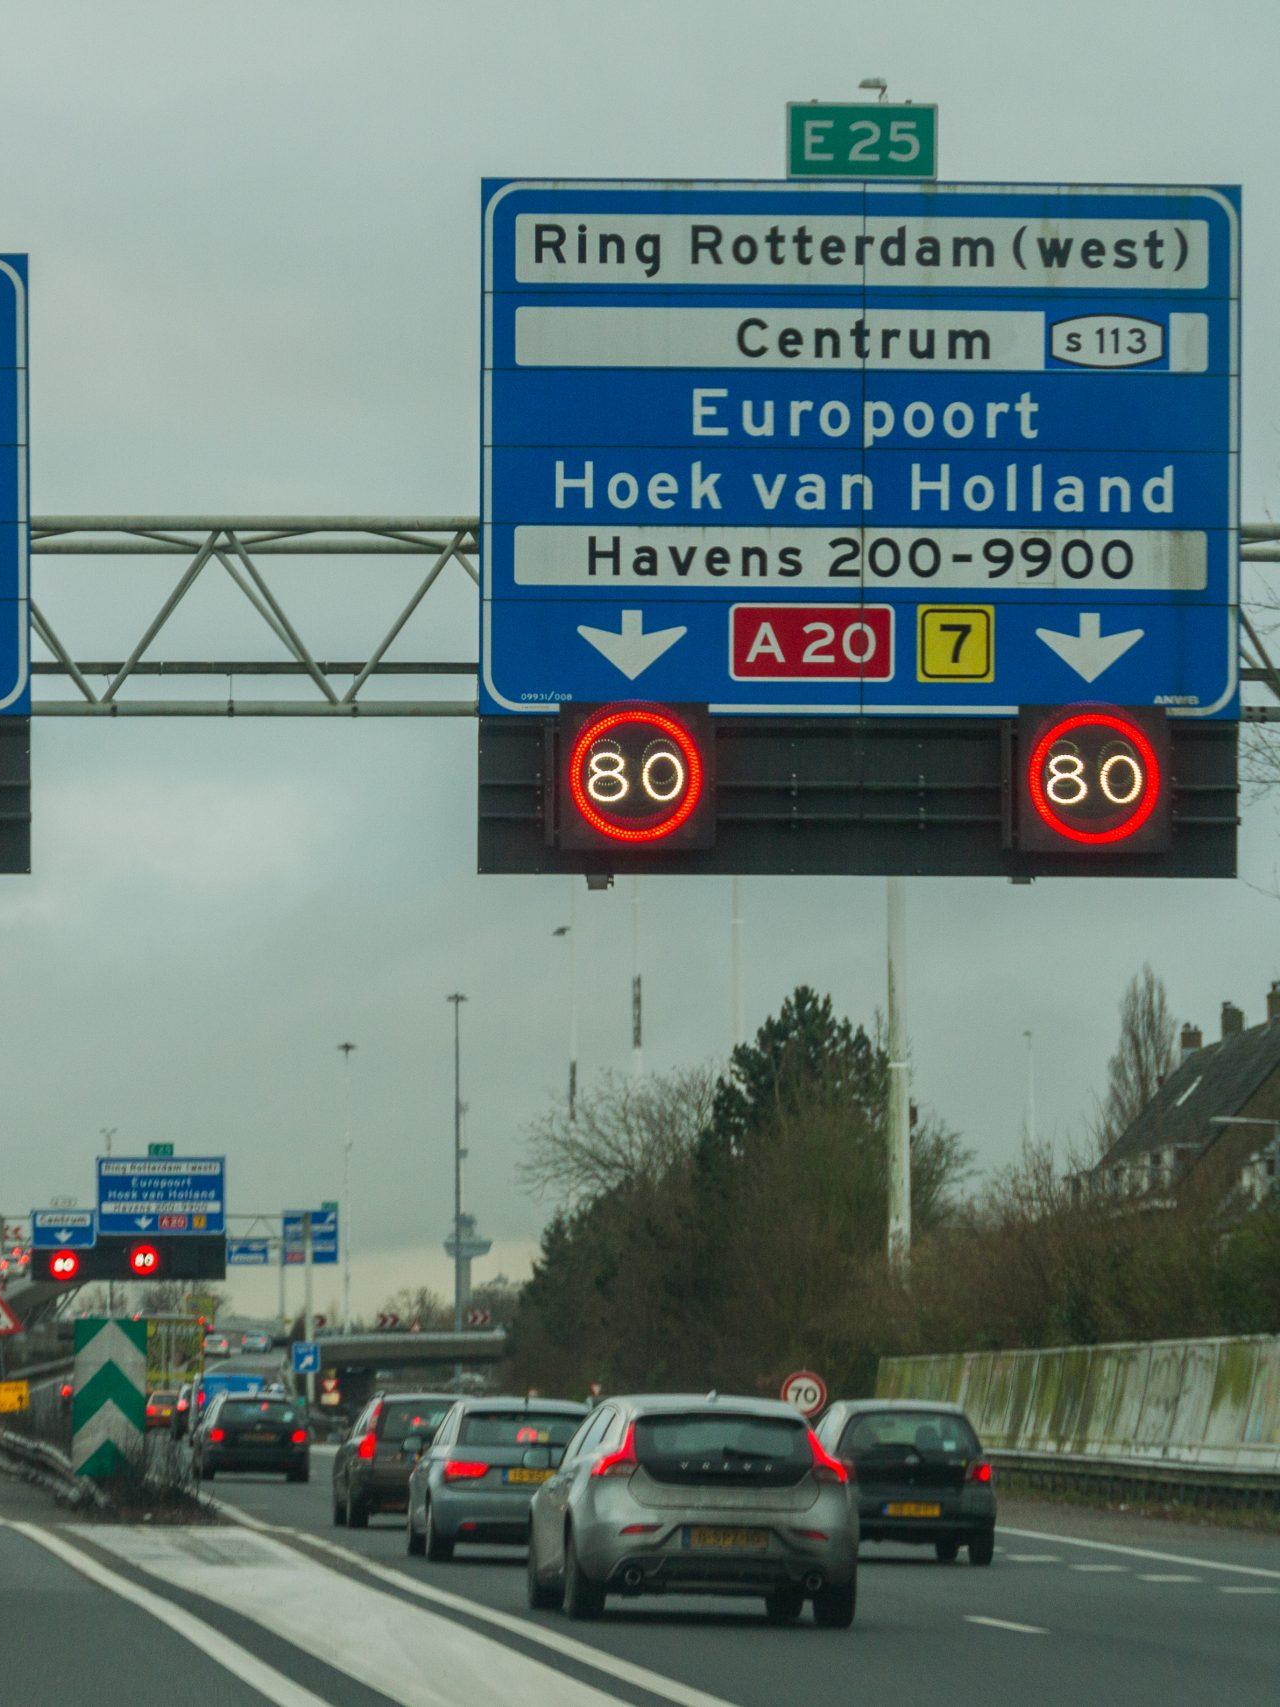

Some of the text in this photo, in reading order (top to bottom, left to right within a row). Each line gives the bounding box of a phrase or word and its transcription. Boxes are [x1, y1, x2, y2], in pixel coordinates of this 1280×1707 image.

[805, 120, 921, 162] E 25
[534, 223, 1190, 279] Ring Rotterdam (west)
[736, 319, 991, 360] Centrum
[1095, 328, 1147, 355] 113
[692, 388, 1040, 448] Europoort
[555, 460, 1174, 514] Hoek van Holland
[587, 536, 1136, 581] Havens 200-9900
[745, 621, 877, 664] A 20
[939, 623, 972, 664] 7
[587, 751, 685, 803] 80
[1046, 754, 1144, 806] 80
[104, 1163, 127, 1175] Ring
[130, 1162, 182, 1173] Rotterdam
[131, 1177, 192, 1189] Europoort
[108, 1189, 216, 1200] Hoek van Holland
[39, 1215, 87, 1225] Centrum
[789, 1385, 818, 1405] 70
